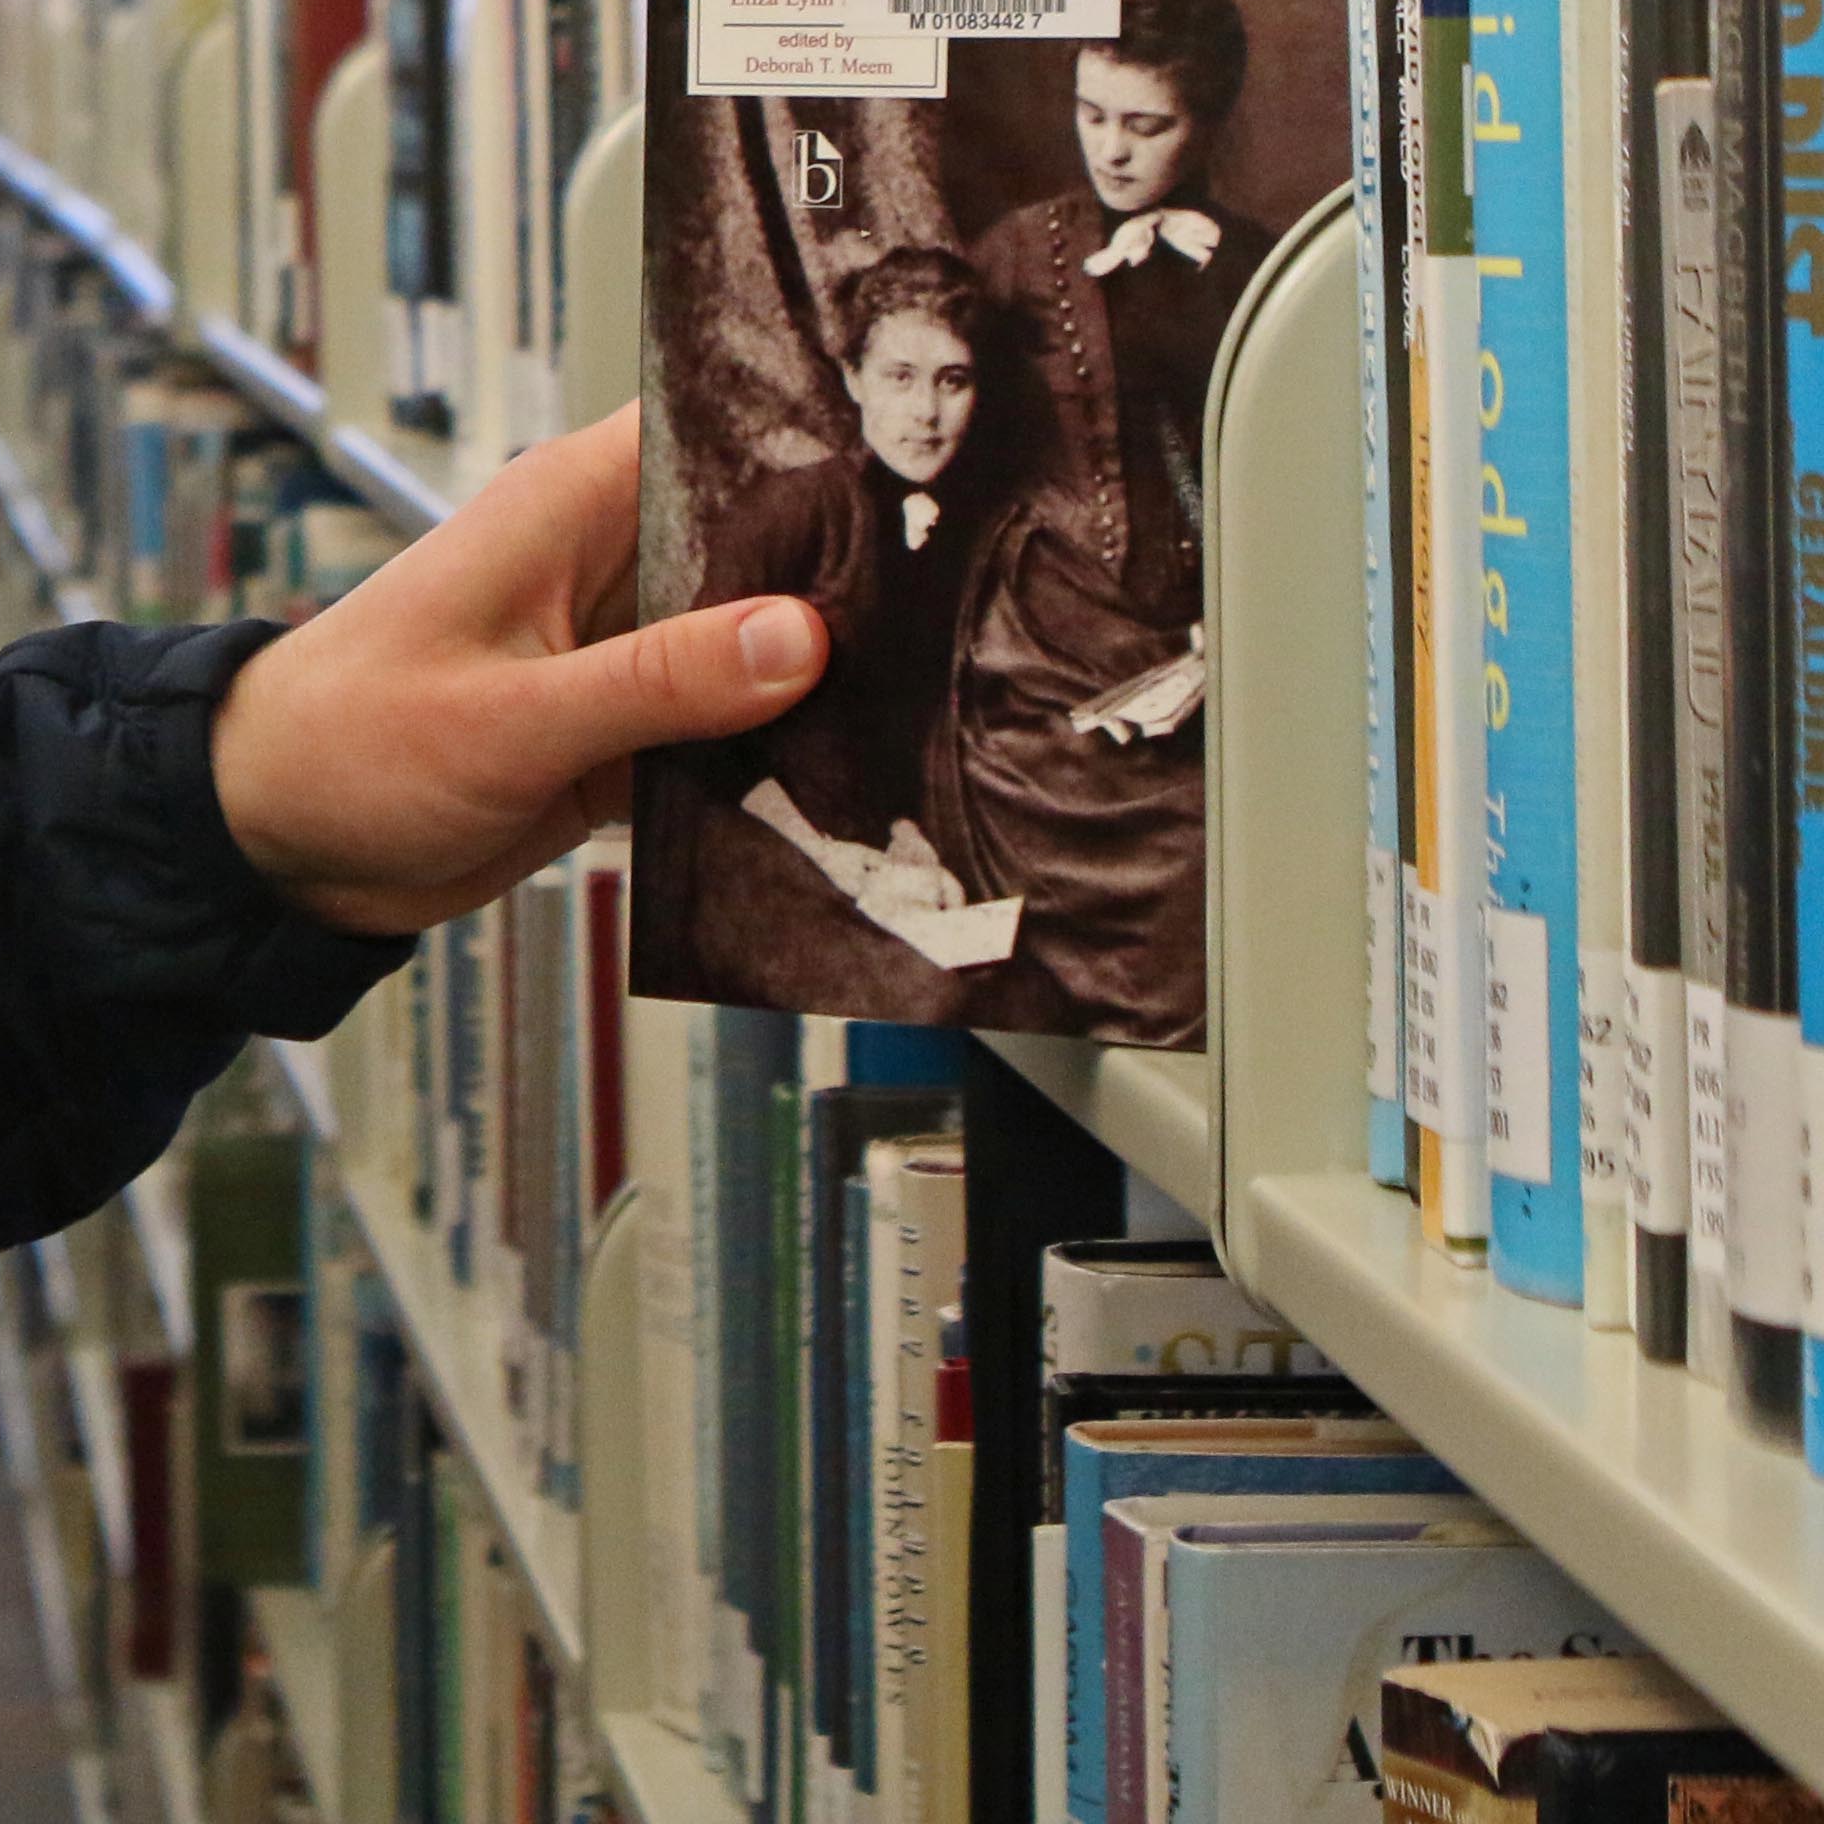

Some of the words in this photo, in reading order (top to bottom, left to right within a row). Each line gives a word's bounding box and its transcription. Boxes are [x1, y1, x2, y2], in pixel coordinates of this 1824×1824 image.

[745, 57, 814, 75] Deborah
[820, 58, 835, 74] T.
[842, 59, 893, 75] Meem
[778, 33, 829, 49] edited
[834, 33, 855, 52] by
[909, 14, 926, 29] M
[932, 13, 1024, 30] 01083442
[1031, 14, 1042, 28] 7
[1410, 118, 1424, 255] LODGE
[1722, 120, 1747, 424] MACBETH
[1780, 75, 1824, 337] DUST
[1416, 426, 1432, 660] Therapy
[1476, 256, 1528, 732] Lodge
[1796, 474, 1824, 813] GERALDINE
[1384, 1773, 1454, 1824] WINNER
